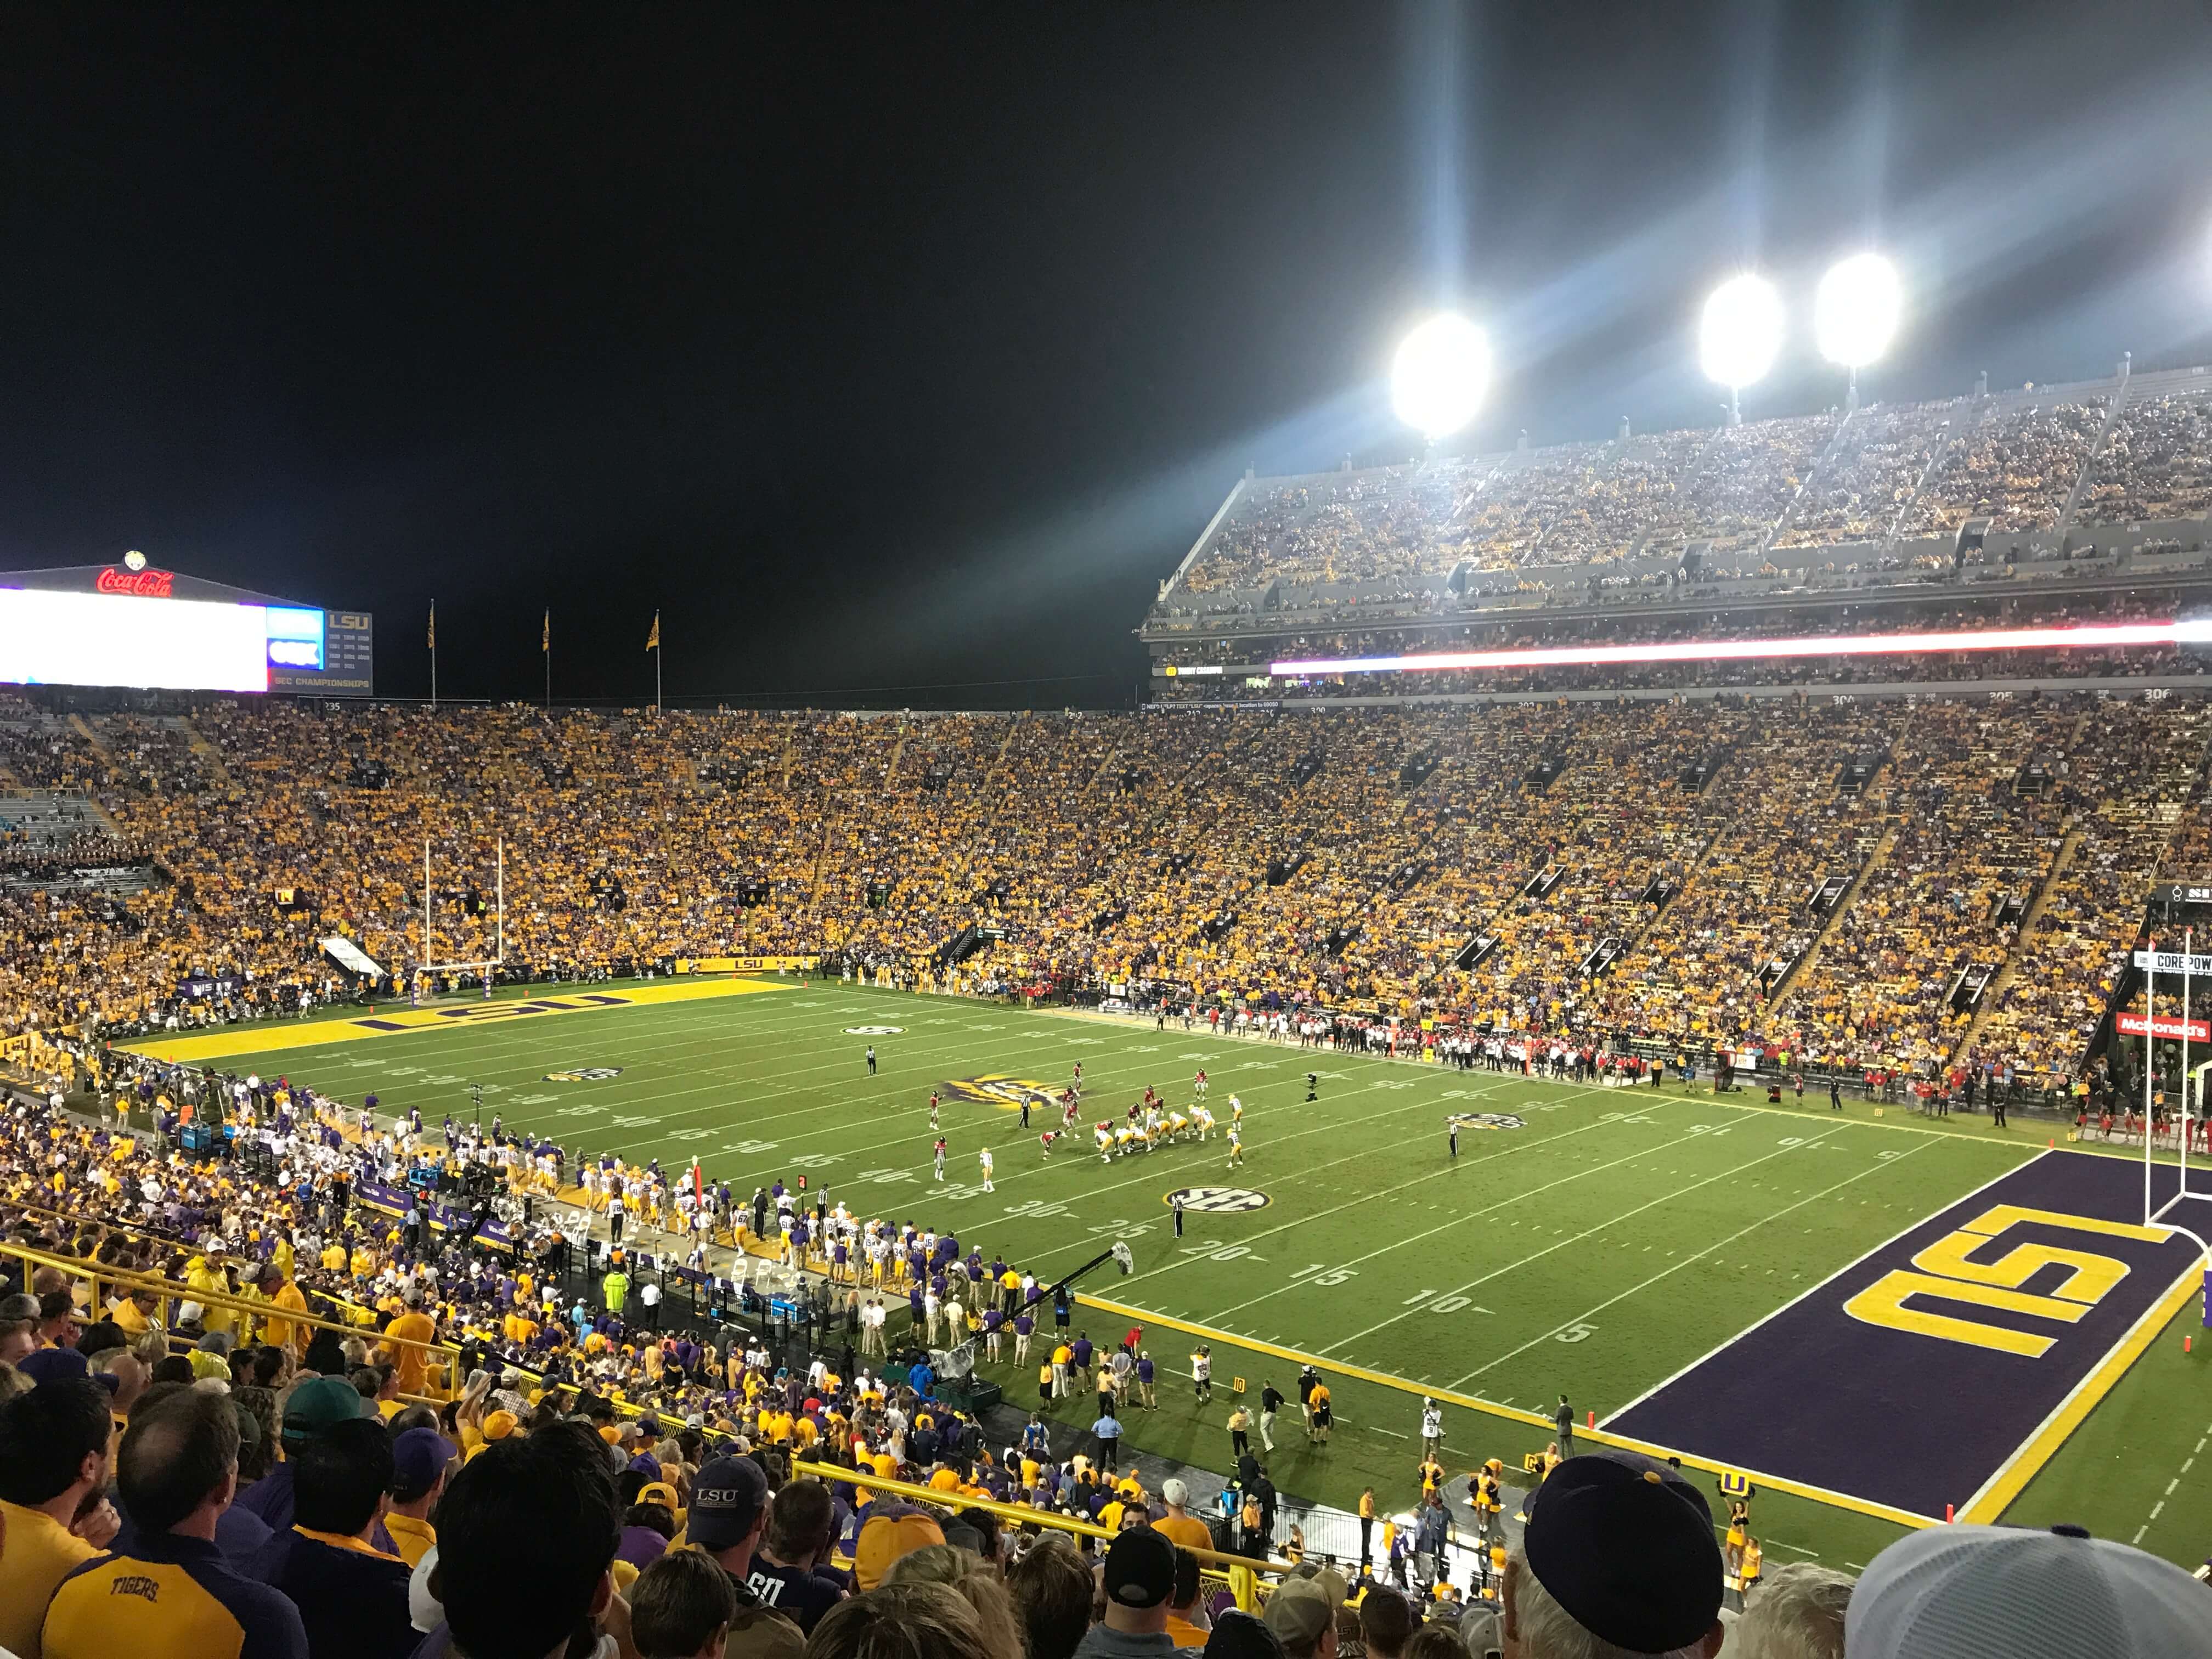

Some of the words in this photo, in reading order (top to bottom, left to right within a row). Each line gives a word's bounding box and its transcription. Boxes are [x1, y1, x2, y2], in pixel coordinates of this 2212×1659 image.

[97, 568, 174, 597] Coca-Cola
[330, 614, 369, 630] LSU
[295, 678, 369, 687] CHAMPIONSHIPS
[735, 960, 763, 969] LSU
[2158, 955, 2185, 969] CORE
[352, 995, 633, 1031] LSU
[1599, 1112, 1651, 1124] 20
[1684, 1124, 1733, 1136] 15
[722, 1139, 780, 1154] 50
[1777, 1137, 1826, 1149] 10
[789, 1154, 845, 1167] 45
[1874, 1150, 1900, 1160] 5
[856, 1169, 913, 1183] 40
[926, 1183, 981, 1200] 35
[1003, 1200, 1068, 1218] 30
[737, 1215, 747, 1223] 67
[826, 1222, 833, 1231] 10
[1087, 1220, 1158, 1239] 25
[926, 1239, 932, 1247] 16
[873, 1250, 879, 1259] 15
[895, 1248, 902, 1257] 34
[1178, 1240, 1252, 1261] 20
[1289, 1264, 1360, 1286] 15
[1843, 1205, 2175, 1359] LSU
[1402, 1290, 1472, 1313] 10
[1555, 1324, 1600, 1343] 5
[1234, 1378, 1245, 1392] 10
[1528, 1456, 1536, 1469] G
[1724, 1474, 1745, 1492] U
[697, 1488, 738, 1502] LSU
[110, 1576, 159, 1601] TIGERS
